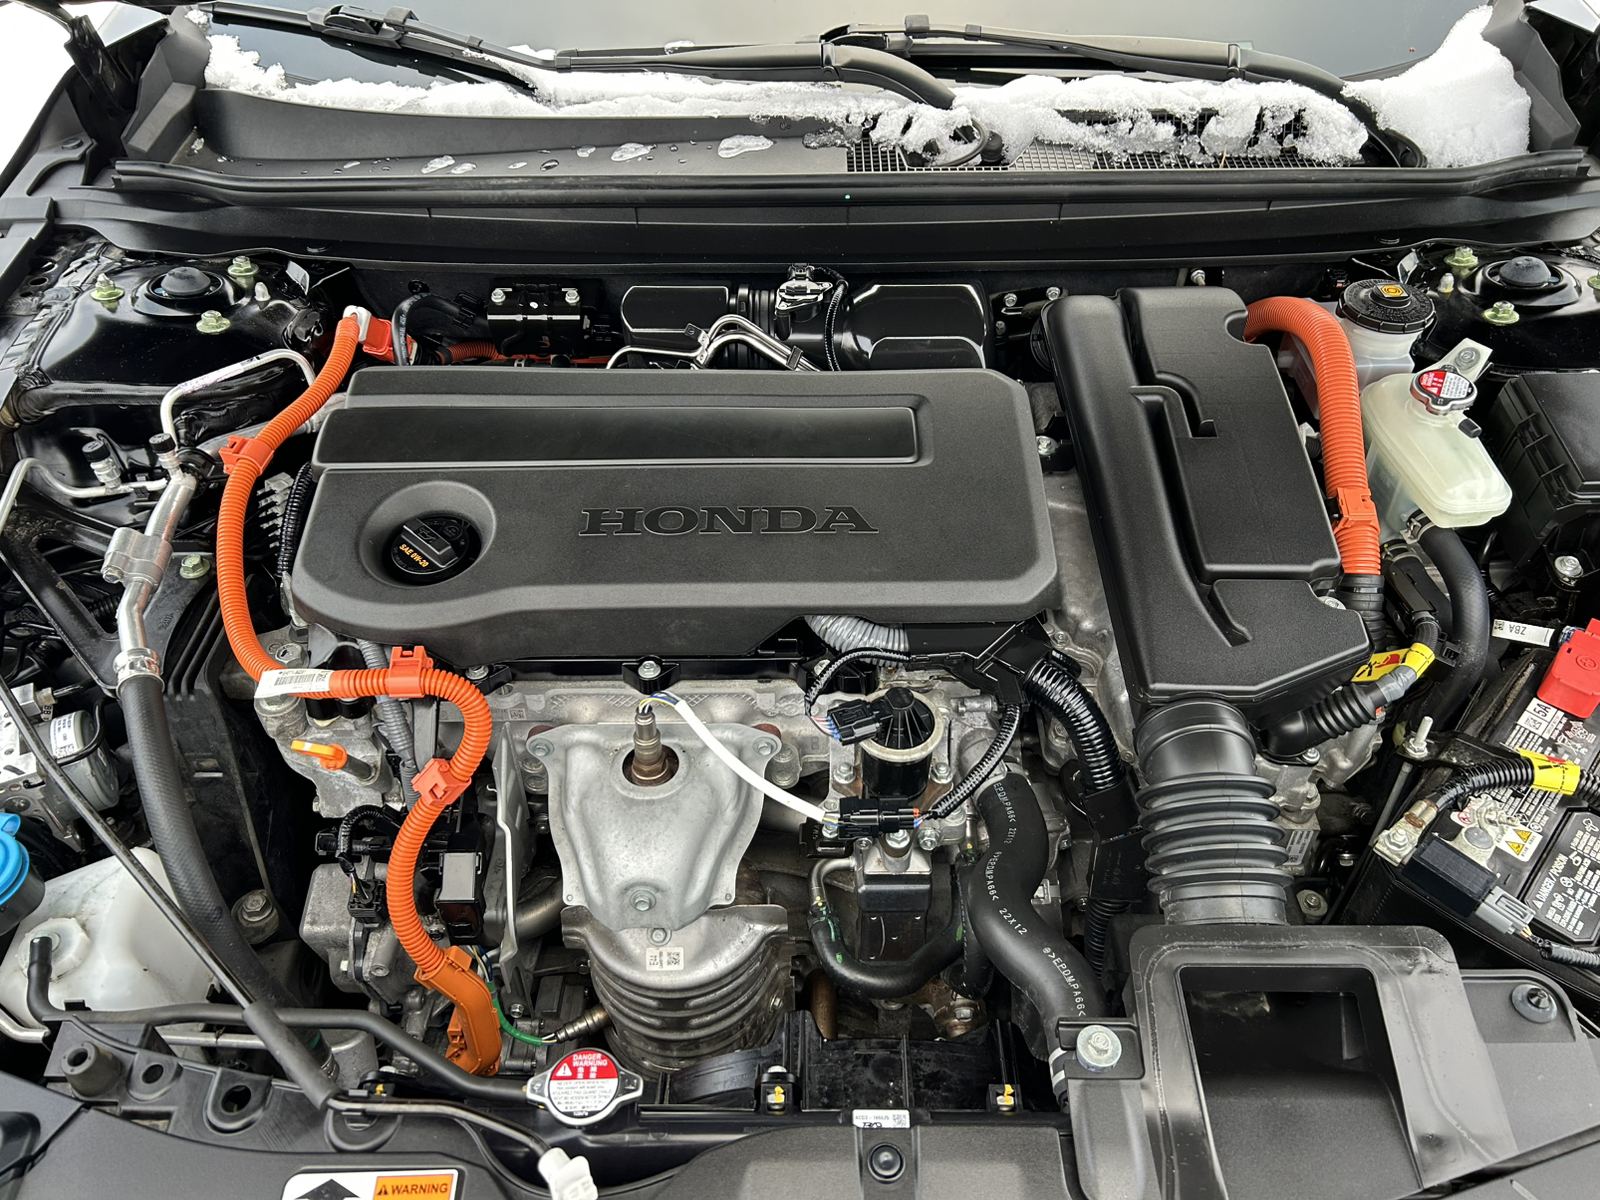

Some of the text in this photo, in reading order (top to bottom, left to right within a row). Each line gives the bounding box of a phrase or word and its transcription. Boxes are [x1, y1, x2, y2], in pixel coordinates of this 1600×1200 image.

[579, 505, 879, 536] HONDA
[399, 543, 414, 555] SAE
[1508, 623, 1527, 636] ZBA
[1533, 703, 1551, 718] 5A
[998, 907, 1028, 935] 22X12
[572, 1059, 608, 1067] WARNUNG
[573, 1053, 602, 1061] DANGER
[391, 1183, 448, 1195] WARNING
